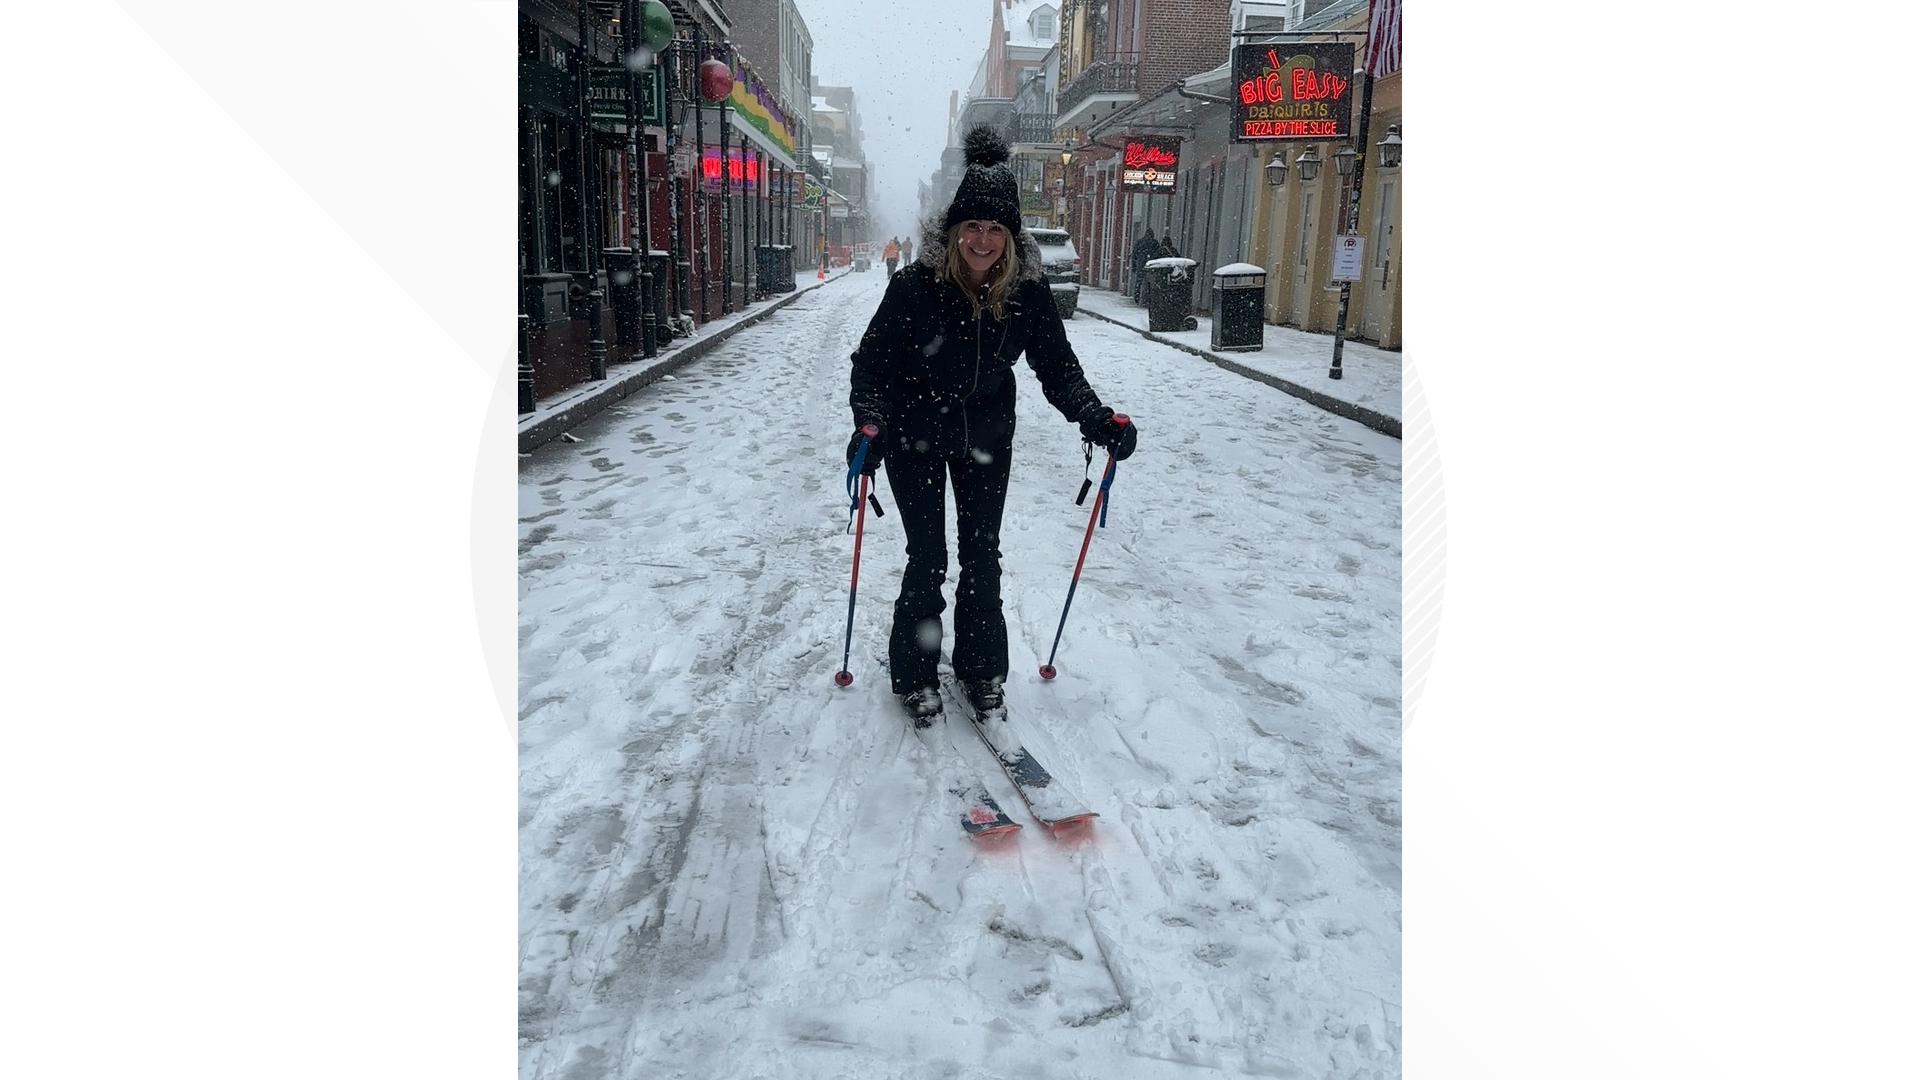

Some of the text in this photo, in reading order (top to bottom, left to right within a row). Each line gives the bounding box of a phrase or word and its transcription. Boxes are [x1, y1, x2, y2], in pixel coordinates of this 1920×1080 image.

[1240, 68, 1347, 104] BIG EASY
[1246, 121, 1337, 135] PIZZA BY THE SLICE
